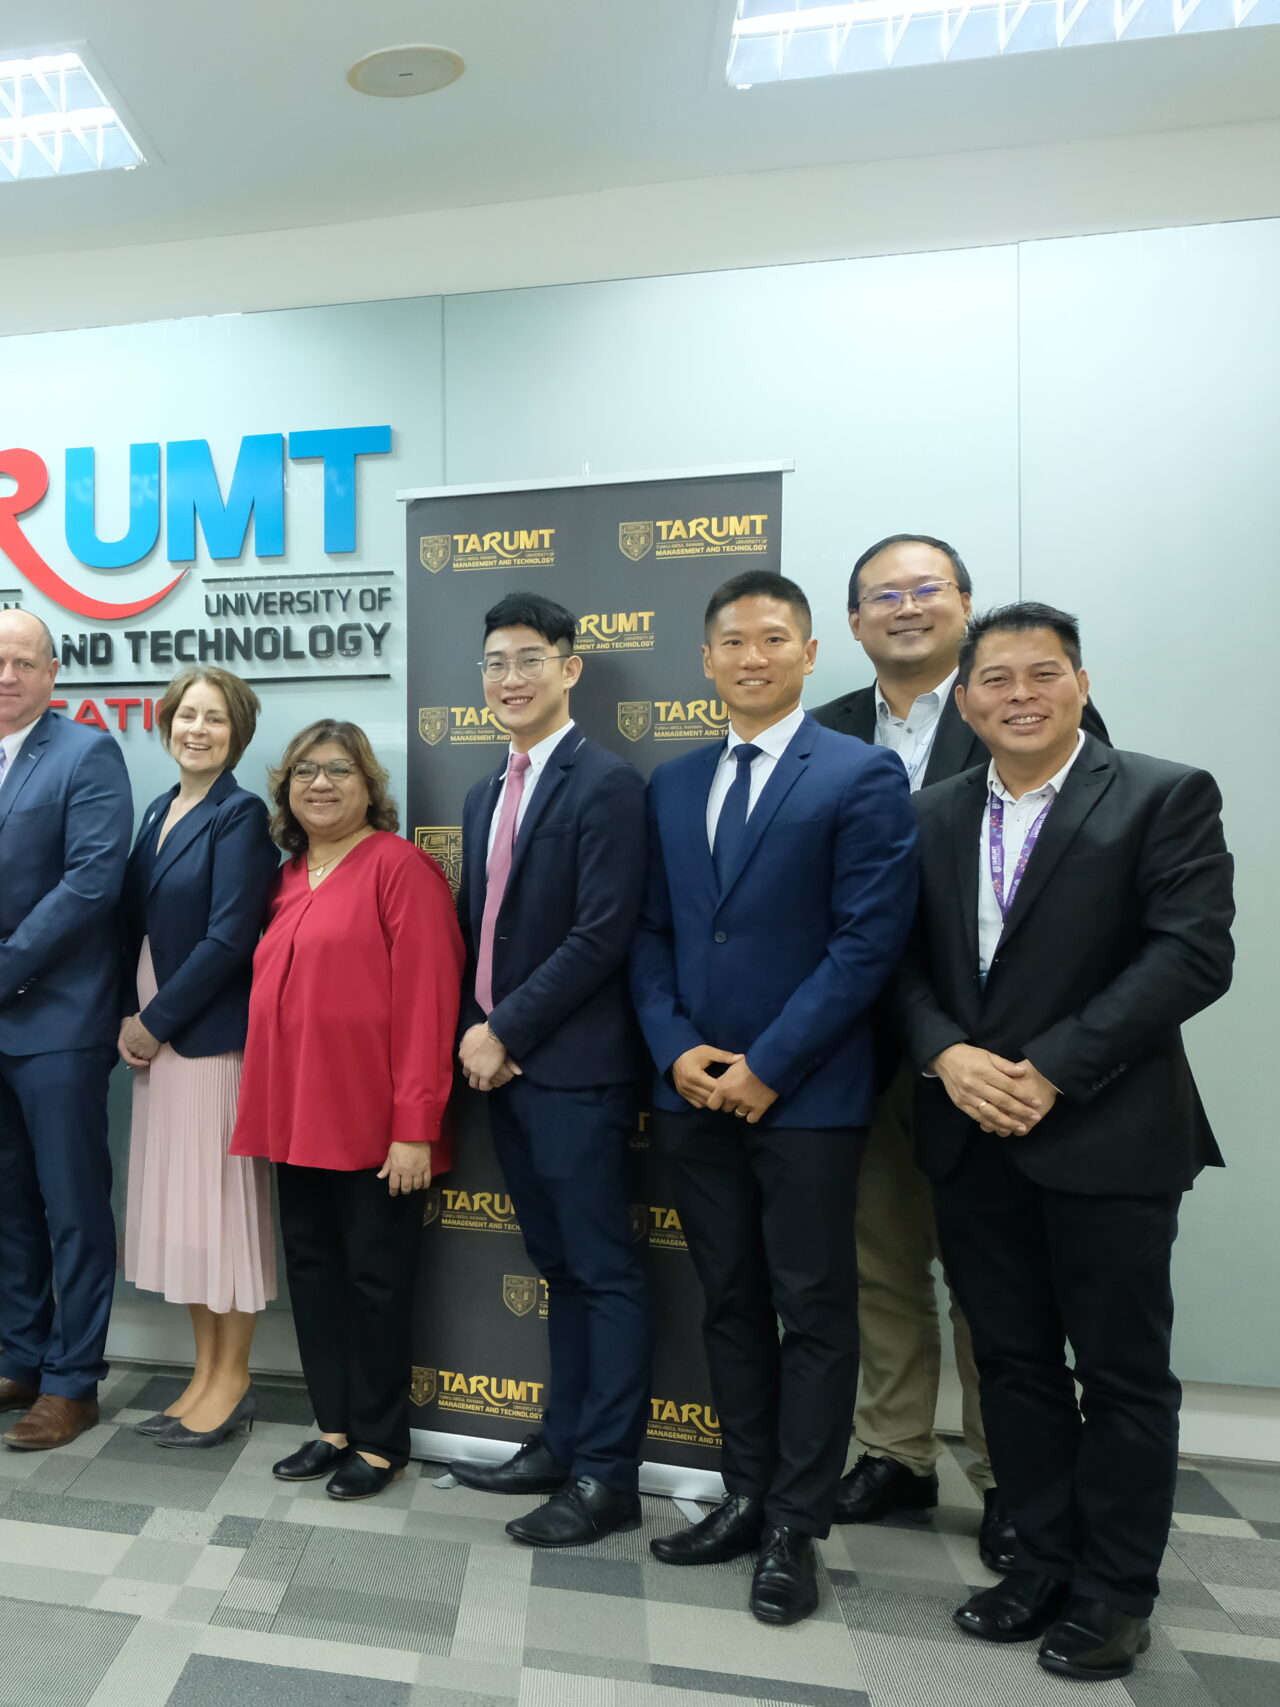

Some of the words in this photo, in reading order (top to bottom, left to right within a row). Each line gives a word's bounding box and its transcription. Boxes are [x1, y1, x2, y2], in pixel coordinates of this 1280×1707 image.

[453, 529, 555, 558] TARUMT
[655, 514, 768, 545] TARUMT
[452, 560, 497, 569] MANAGEMENT
[513, 557, 555, 565] TECHNOLOGY
[655, 547, 704, 556] MANAGEMENT
[722, 544, 768, 552] TECHNOLOGY
[205, 588, 352, 617] UNIVERSITY
[358, 587, 392, 612] OF
[575, 611, 655, 642] RUMT
[52, 631, 113, 667] ND
[124, 622, 392, 665] TECHNOLOGY
[611, 640, 655, 648] TECHNOLOGY
[654, 699, 731, 729] TARU
[450, 734, 496, 742] MANAGEMENT
[442, 1189, 516, 1222] TARU
[441, 1218, 487, 1228] MANAGEMENT
[649, 1237, 688, 1247] MANAGEM
[438, 1370, 544, 1407] TARUMT
[438, 1400, 484, 1412] MANAGEMENT
[485, 1406, 499, 1414] AND
[500, 1408, 544, 1419] TECHNOLOGY
[650, 1398, 722, 1437] TARU
[646, 1429, 697, 1442] MANAGEMENT
[698, 1436, 714, 1444] AND
